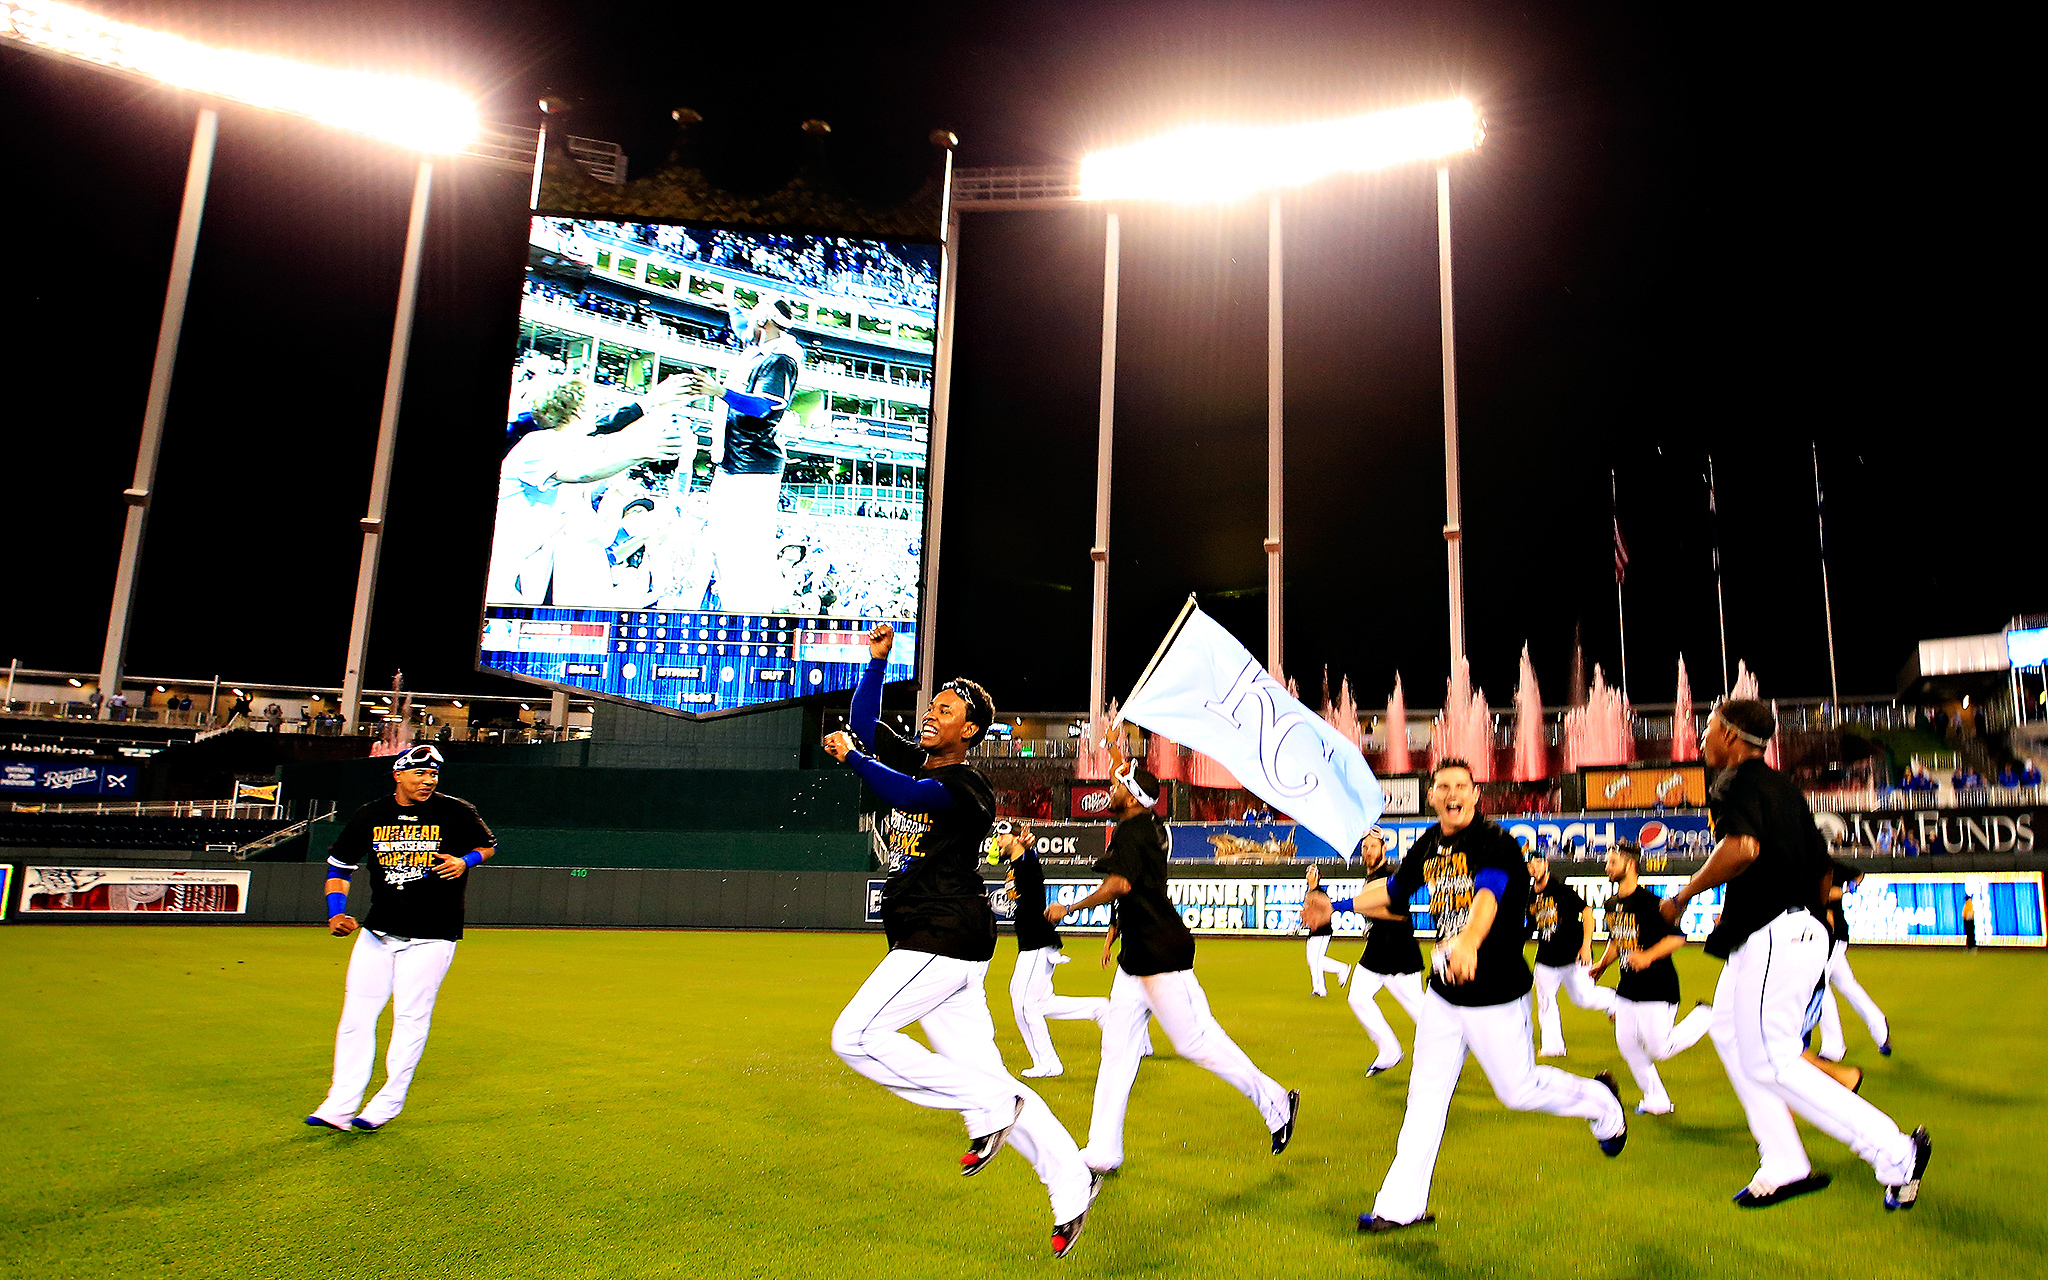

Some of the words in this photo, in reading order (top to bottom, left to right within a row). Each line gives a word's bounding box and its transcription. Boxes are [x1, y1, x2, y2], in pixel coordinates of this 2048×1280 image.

[620, 613, 629, 623] 1
[619, 626, 629, 638] 1
[681, 628, 690, 639] 1
[760, 631, 768, 642] 1
[568, 664, 600, 675] BALL
[622, 662, 637, 680] 0
[721, 666, 735, 683] 0
[760, 670, 785, 681] OUT
[809, 668, 823, 686] 0
[43, 767, 99, 790] Royals
[372, 826, 400, 841] OUR
[402, 825, 443, 841] YEAR.
[1914, 810, 2035, 854] FUNDS
[1037, 837, 1078, 854] OCK
[570, 869, 588, 878] 410
[1182, 907, 1243, 929] OSER
